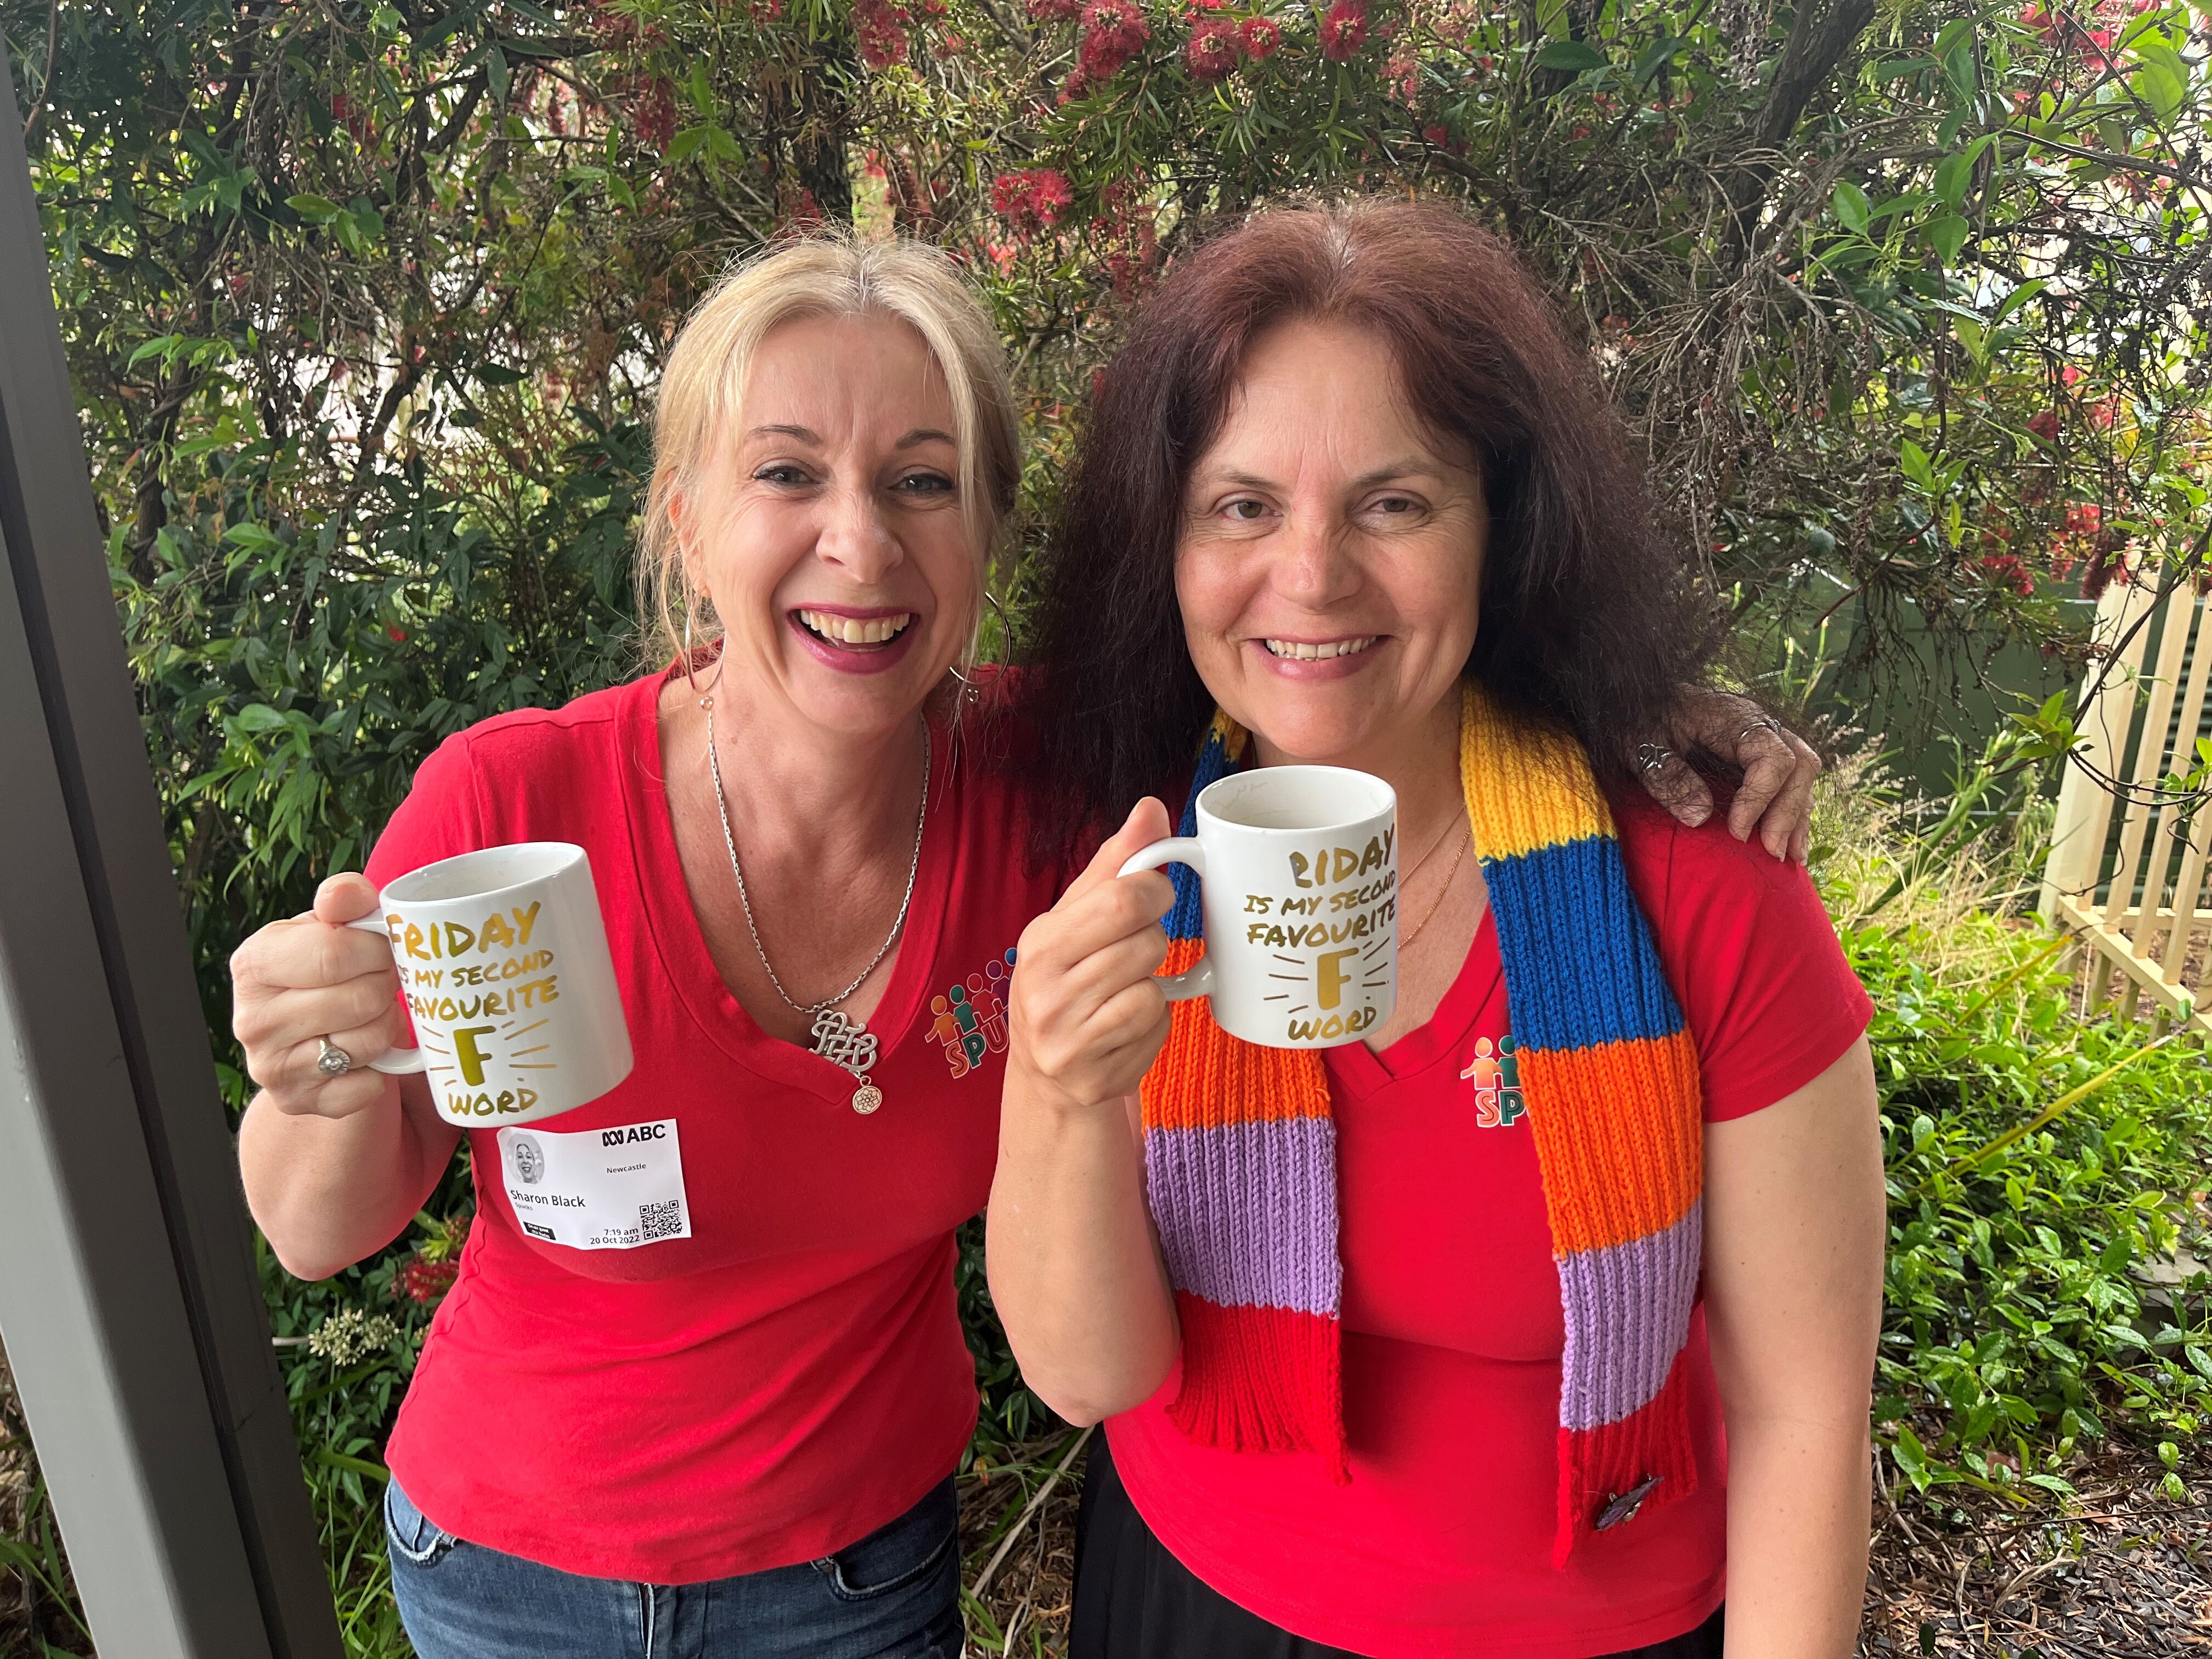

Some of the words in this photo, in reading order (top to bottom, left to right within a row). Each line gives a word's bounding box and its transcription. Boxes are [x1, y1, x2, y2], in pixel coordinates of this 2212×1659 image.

[1243, 894, 1273, 915] IS
[1280, 896, 1322, 916] MY
[1329, 870, 1396, 913] SECOND
[385, 900, 541, 961] FRIDAY
[1246, 894, 1396, 947] FAVOURITE
[415, 969, 444, 989] MY
[450, 950, 554, 988] SECOND
[1317, 947, 1359, 1011] F
[1288, 1006, 1377, 1041] WORD
[453, 1025, 496, 1086] F
[945, 1009, 1009, 1079] SPU
[448, 1088, 538, 1116] WORD
[1475, 1089, 1530, 1128] SP
[627, 1124, 666, 1144] ABC
[606, 1163, 647, 1174] Newcastle
[510, 1189, 549, 1205] Sharon
[551, 1195, 586, 1207] Black
[618, 1235, 640, 1244] 2022
